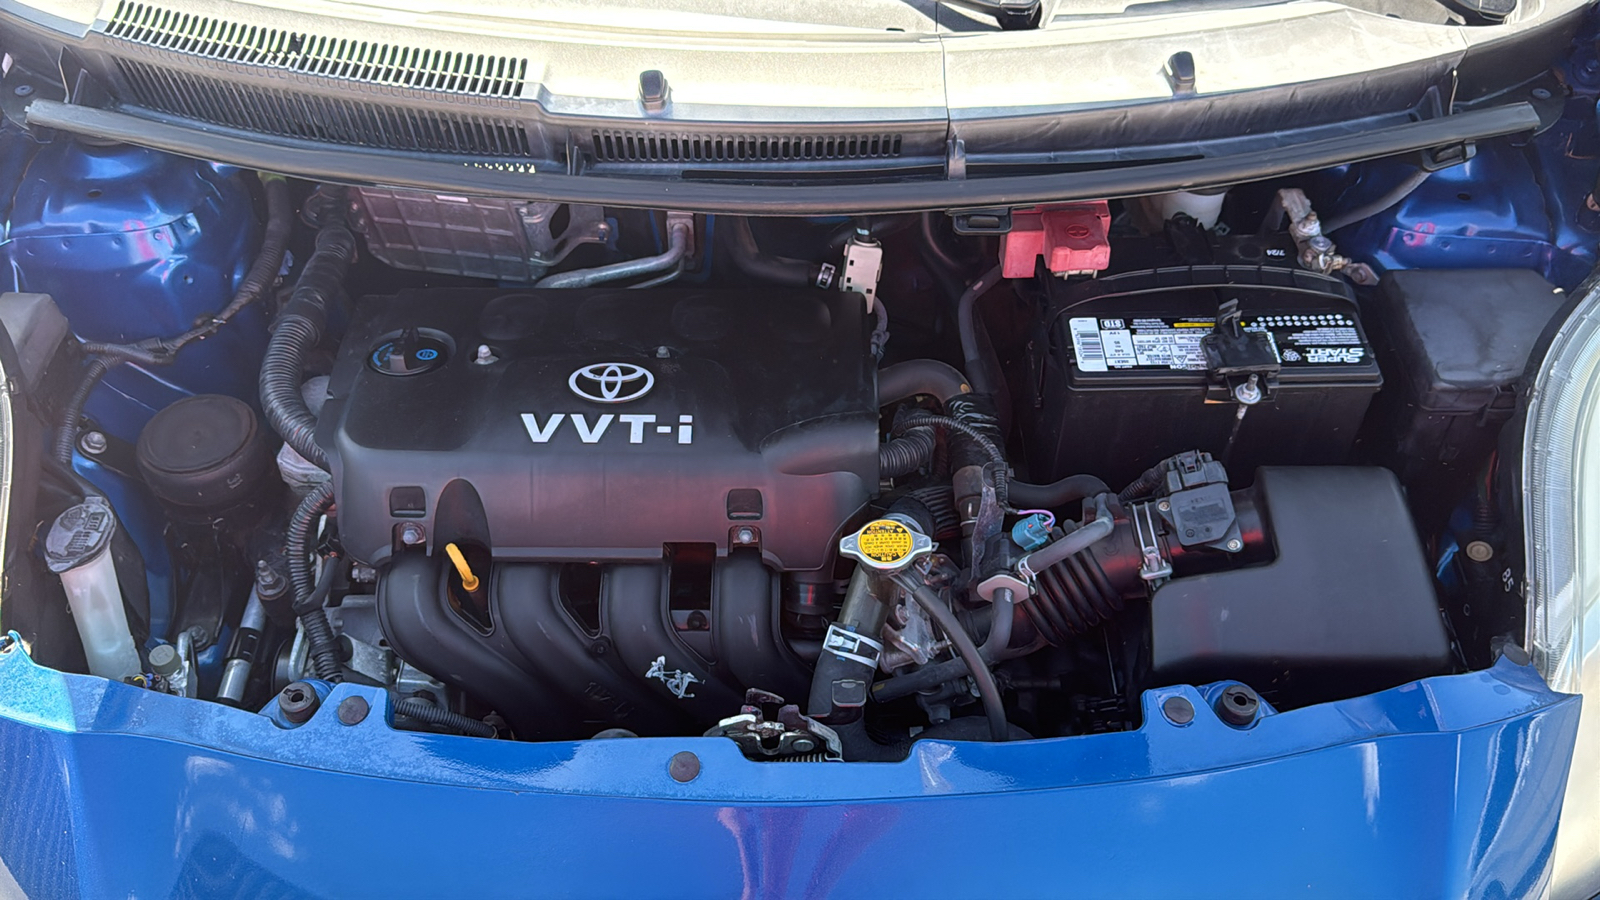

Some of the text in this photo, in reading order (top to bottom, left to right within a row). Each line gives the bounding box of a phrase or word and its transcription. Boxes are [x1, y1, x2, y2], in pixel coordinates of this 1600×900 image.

[1307, 355, 1360, 363] SUPER
[520, 413, 694, 444] VVT-i
[1502, 567, 1514, 592] 85
